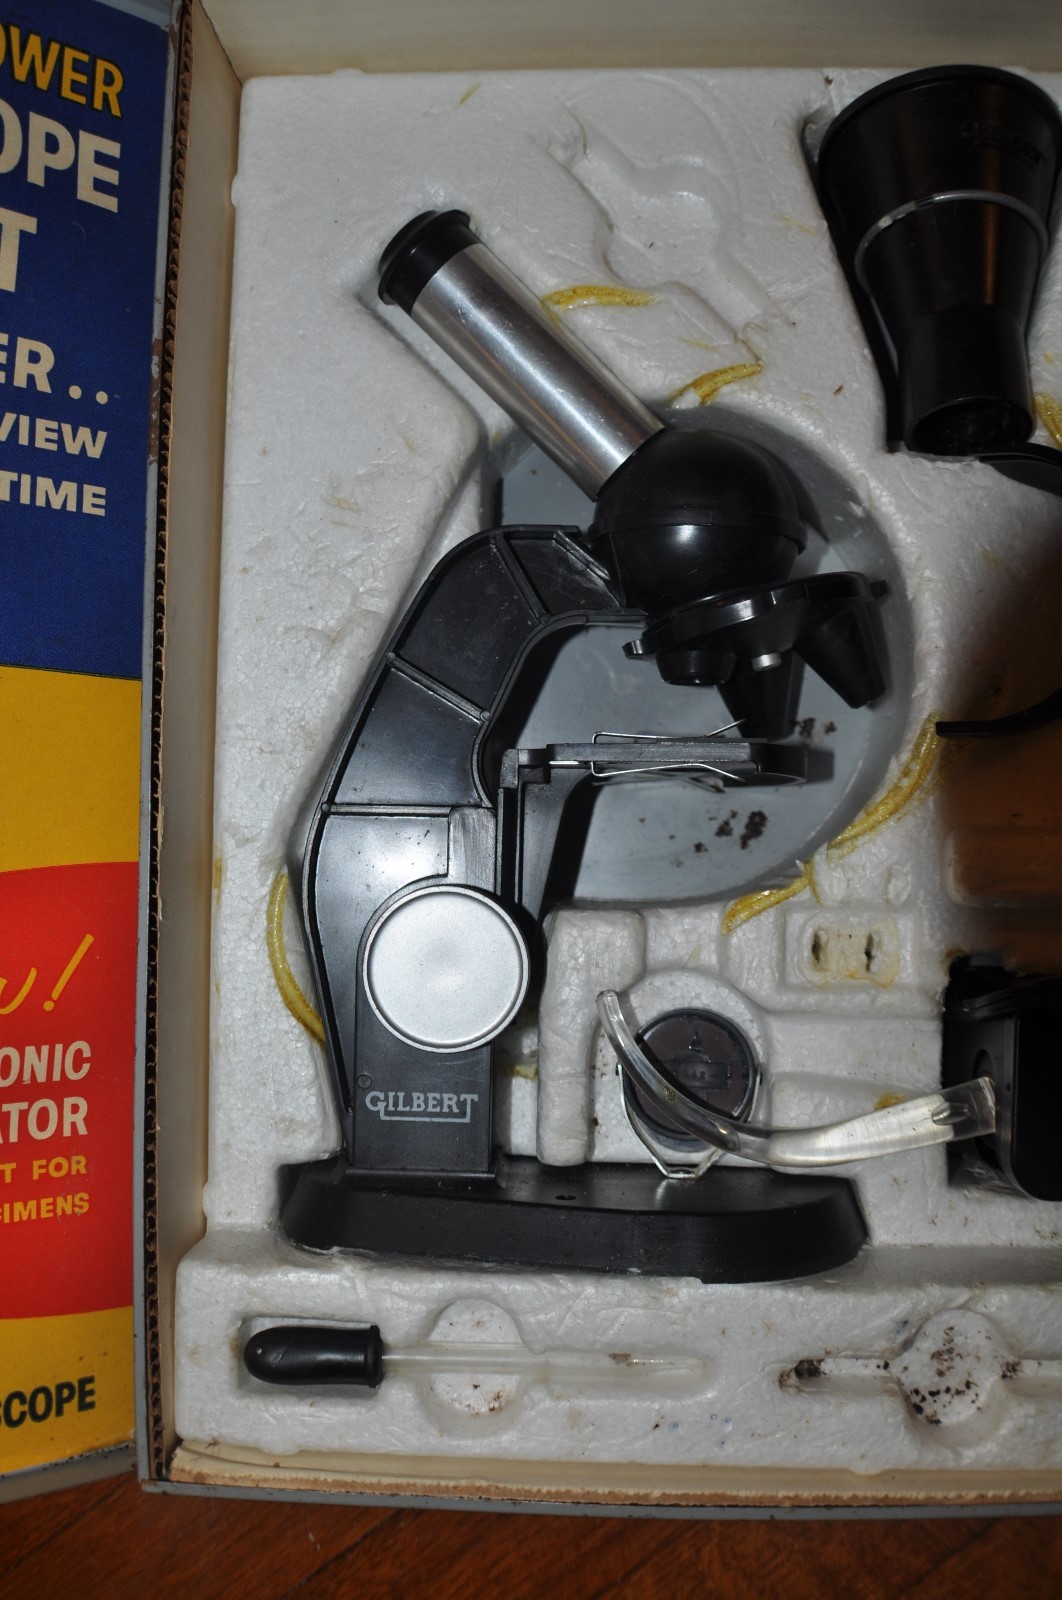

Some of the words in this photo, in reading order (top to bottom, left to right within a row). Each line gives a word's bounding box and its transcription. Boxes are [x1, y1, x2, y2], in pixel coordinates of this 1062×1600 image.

[0, 22, 124, 118] WER
[0, 470, 106, 517] TIME
[0, 1040, 92, 1088] ONIC
[0, 1096, 88, 1144] TOR
[365, 1091, 479, 1123] GILBERT
[32, 1154, 87, 1180] FOR
[0, 1192, 90, 1224] IMENS
[0, 1375, 96, 1428] COPE
